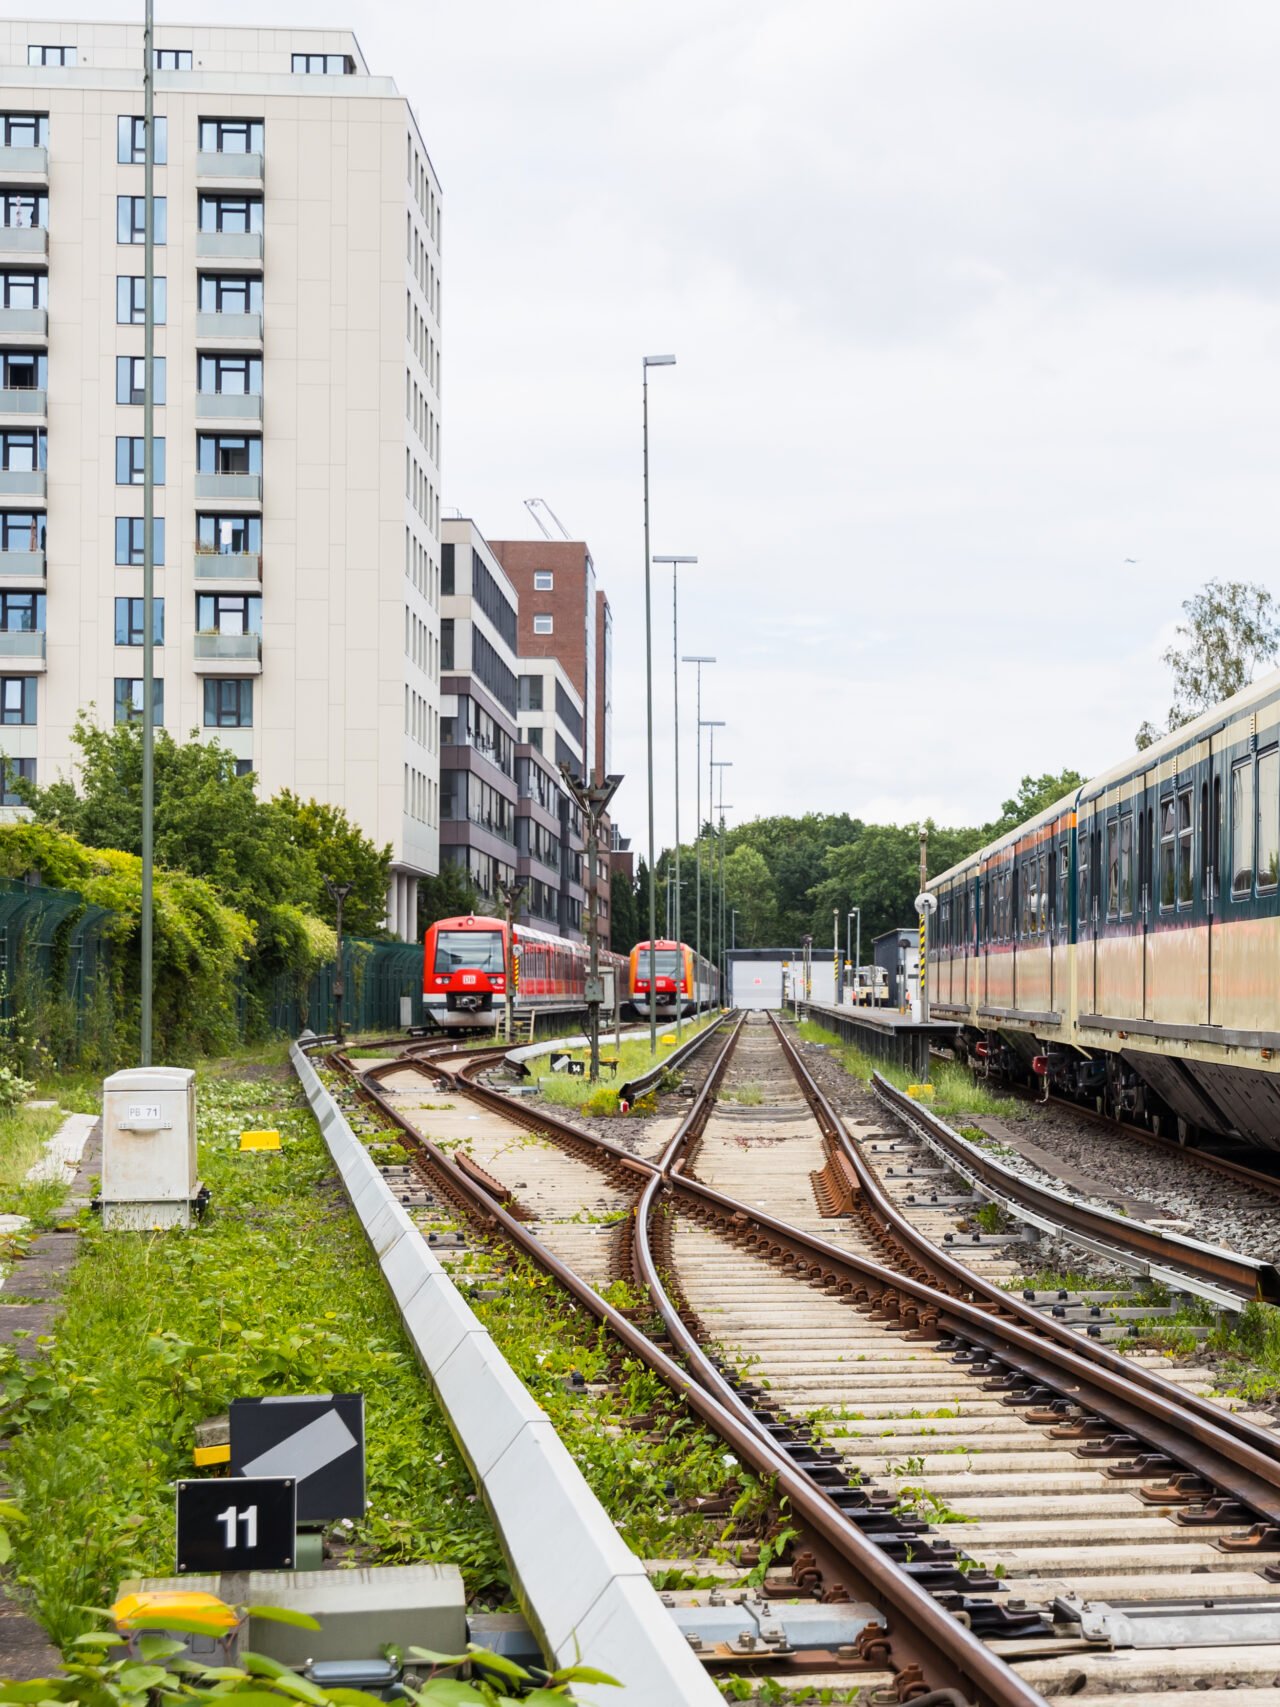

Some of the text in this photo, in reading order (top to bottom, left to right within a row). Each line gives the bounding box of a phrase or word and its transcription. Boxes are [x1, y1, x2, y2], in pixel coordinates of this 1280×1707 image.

[572, 1064, 580, 1072] 14
[146, 1107, 157, 1117] 71
[216, 1505, 257, 1549] 11
